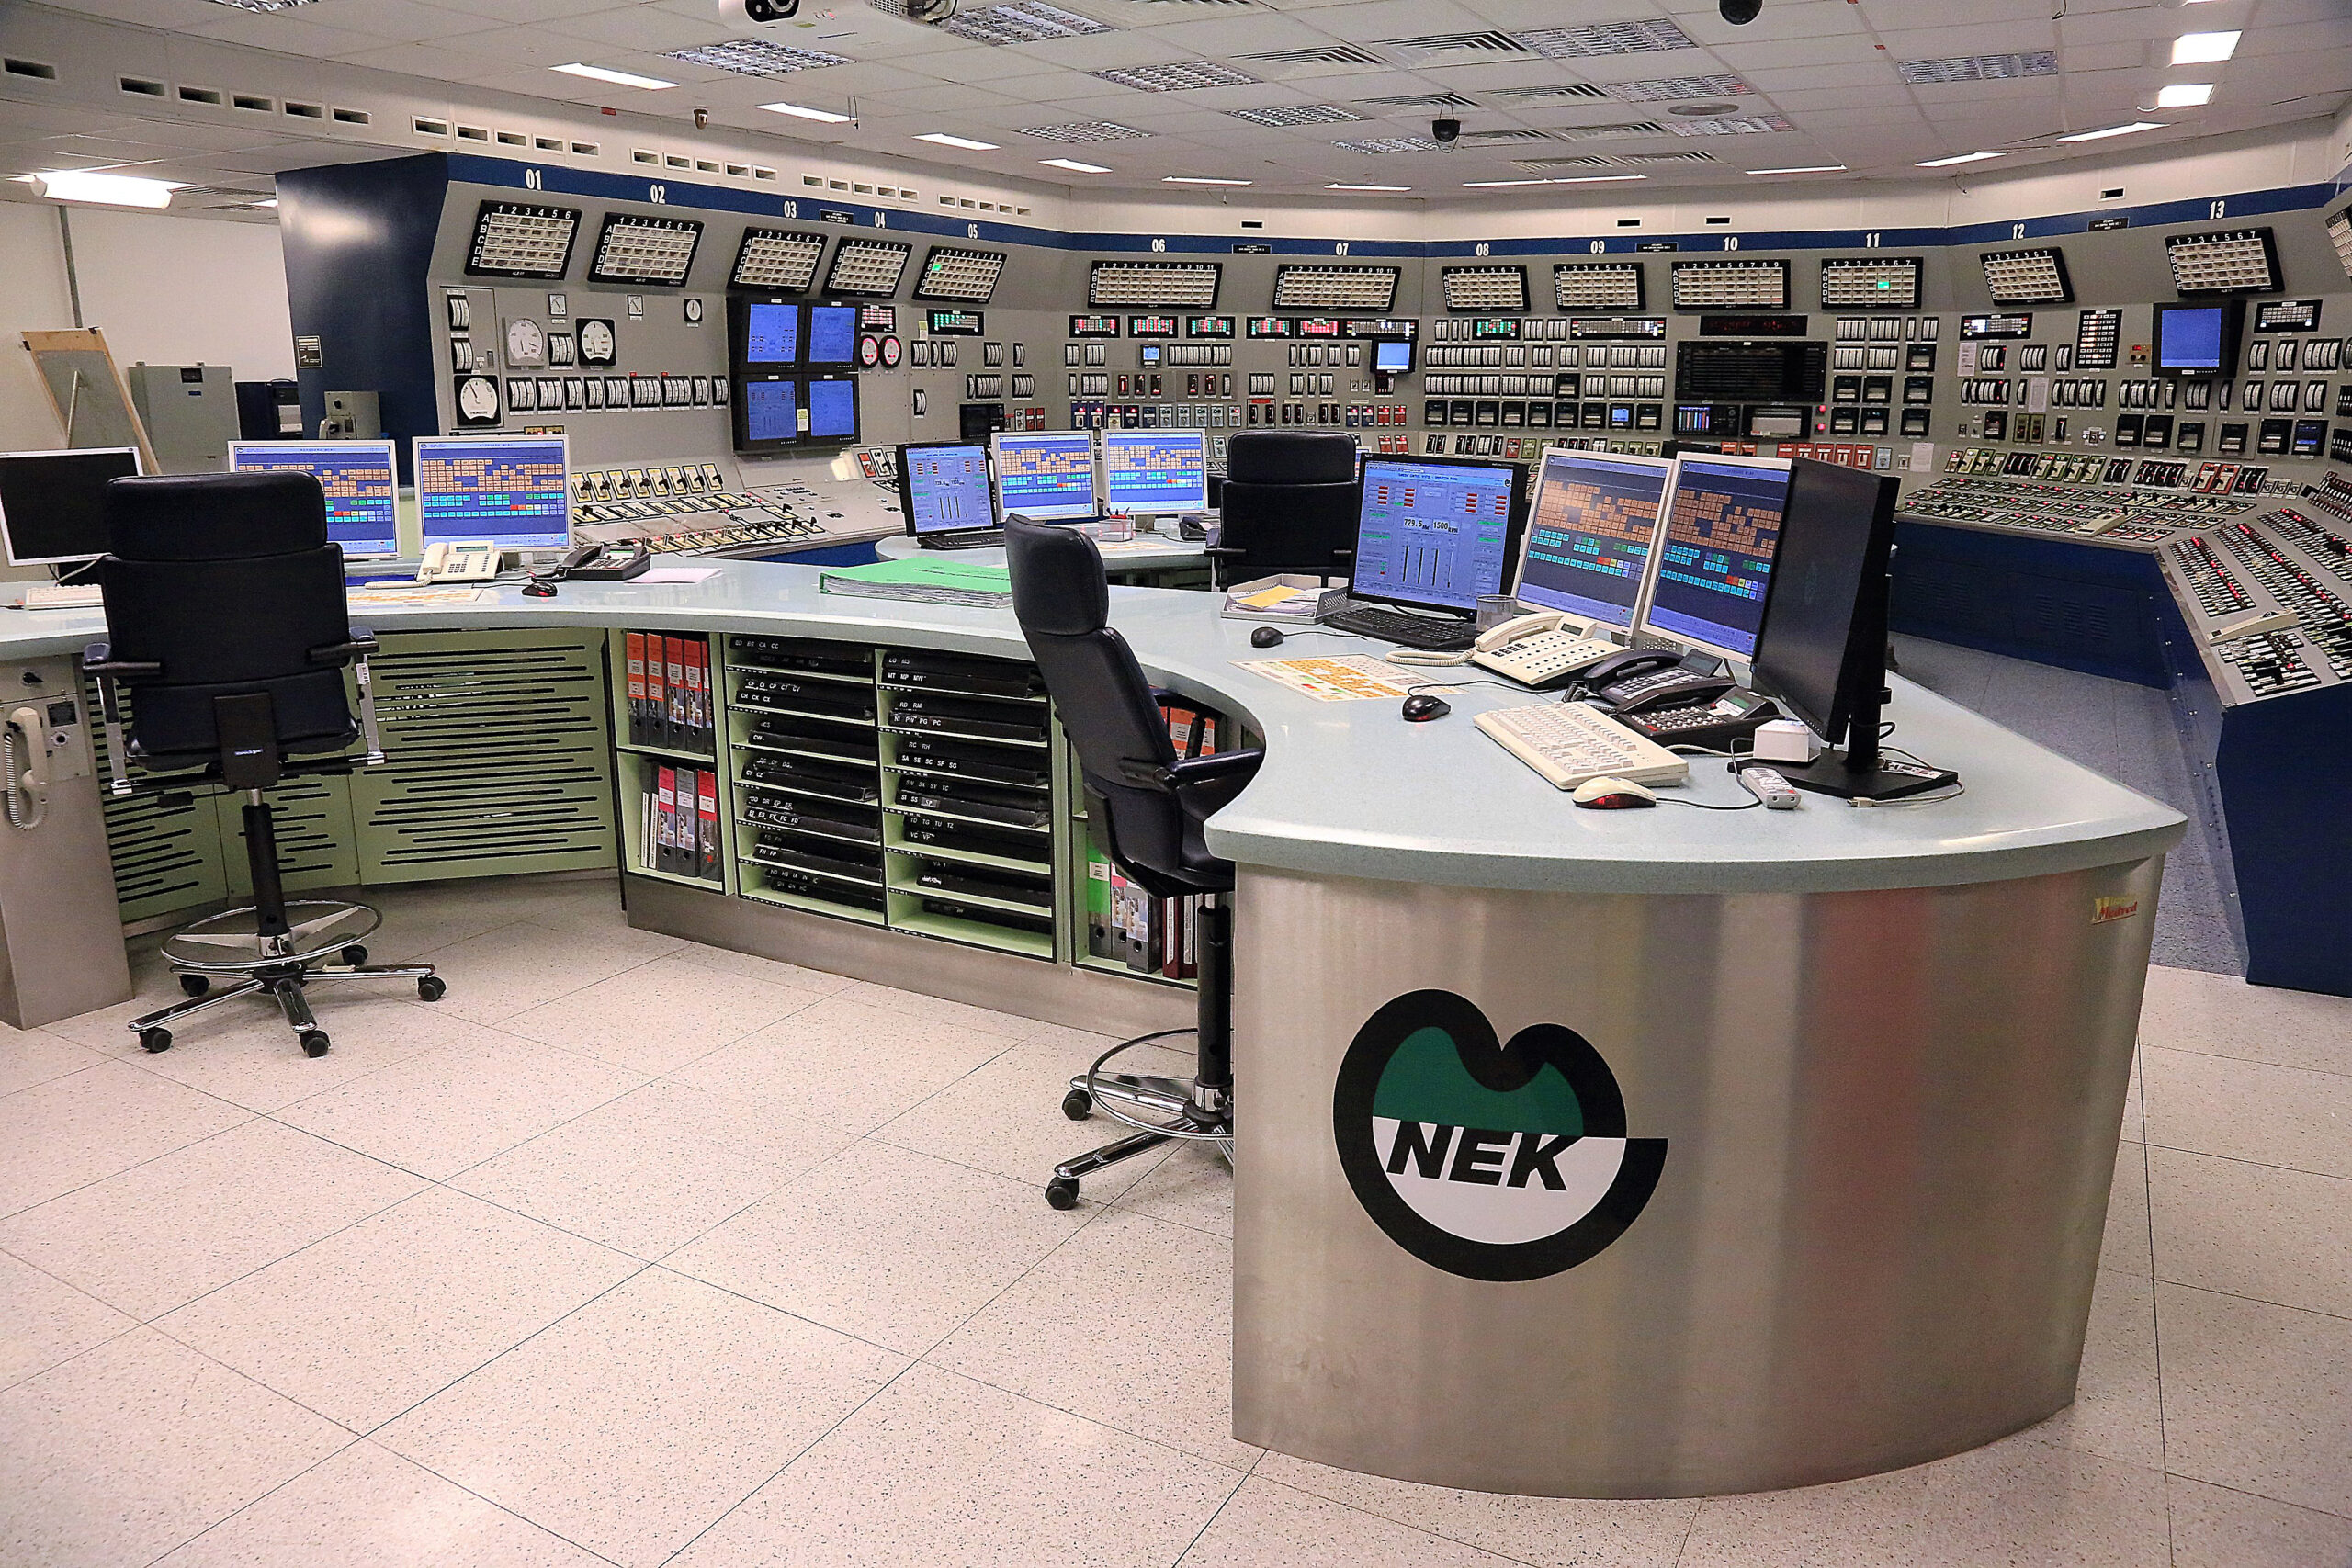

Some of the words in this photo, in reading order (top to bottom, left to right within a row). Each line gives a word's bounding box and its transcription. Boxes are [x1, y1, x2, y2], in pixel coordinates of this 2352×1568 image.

[525, 169, 542, 191] 01
[650, 185, 665, 204] 02
[498, 205, 503, 213] 1
[525, 207, 531, 215] 3
[784, 201, 797, 219] 03
[2209, 202, 2226, 220] 13
[482, 214, 489, 222] A
[874, 212, 886, 229] 04
[480, 225, 487, 234] B
[606, 225, 613, 233] A
[967, 224, 978, 239] 05
[2013, 223, 2025, 240] 12
[478, 236, 484, 244] C
[1151, 239, 1166, 253] 06
[1590, 240, 1605, 254] 09
[1723, 237, 1738, 251] 10
[1866, 233, 1880, 248] 11
[474, 246, 481, 255] D
[1335, 243, 1349, 257] 07
[1476, 243, 1490, 257] 08
[472, 257, 479, 266] E
[1404, 519, 1422, 527] 729.6
[1387, 1120, 1583, 1192] NEK
